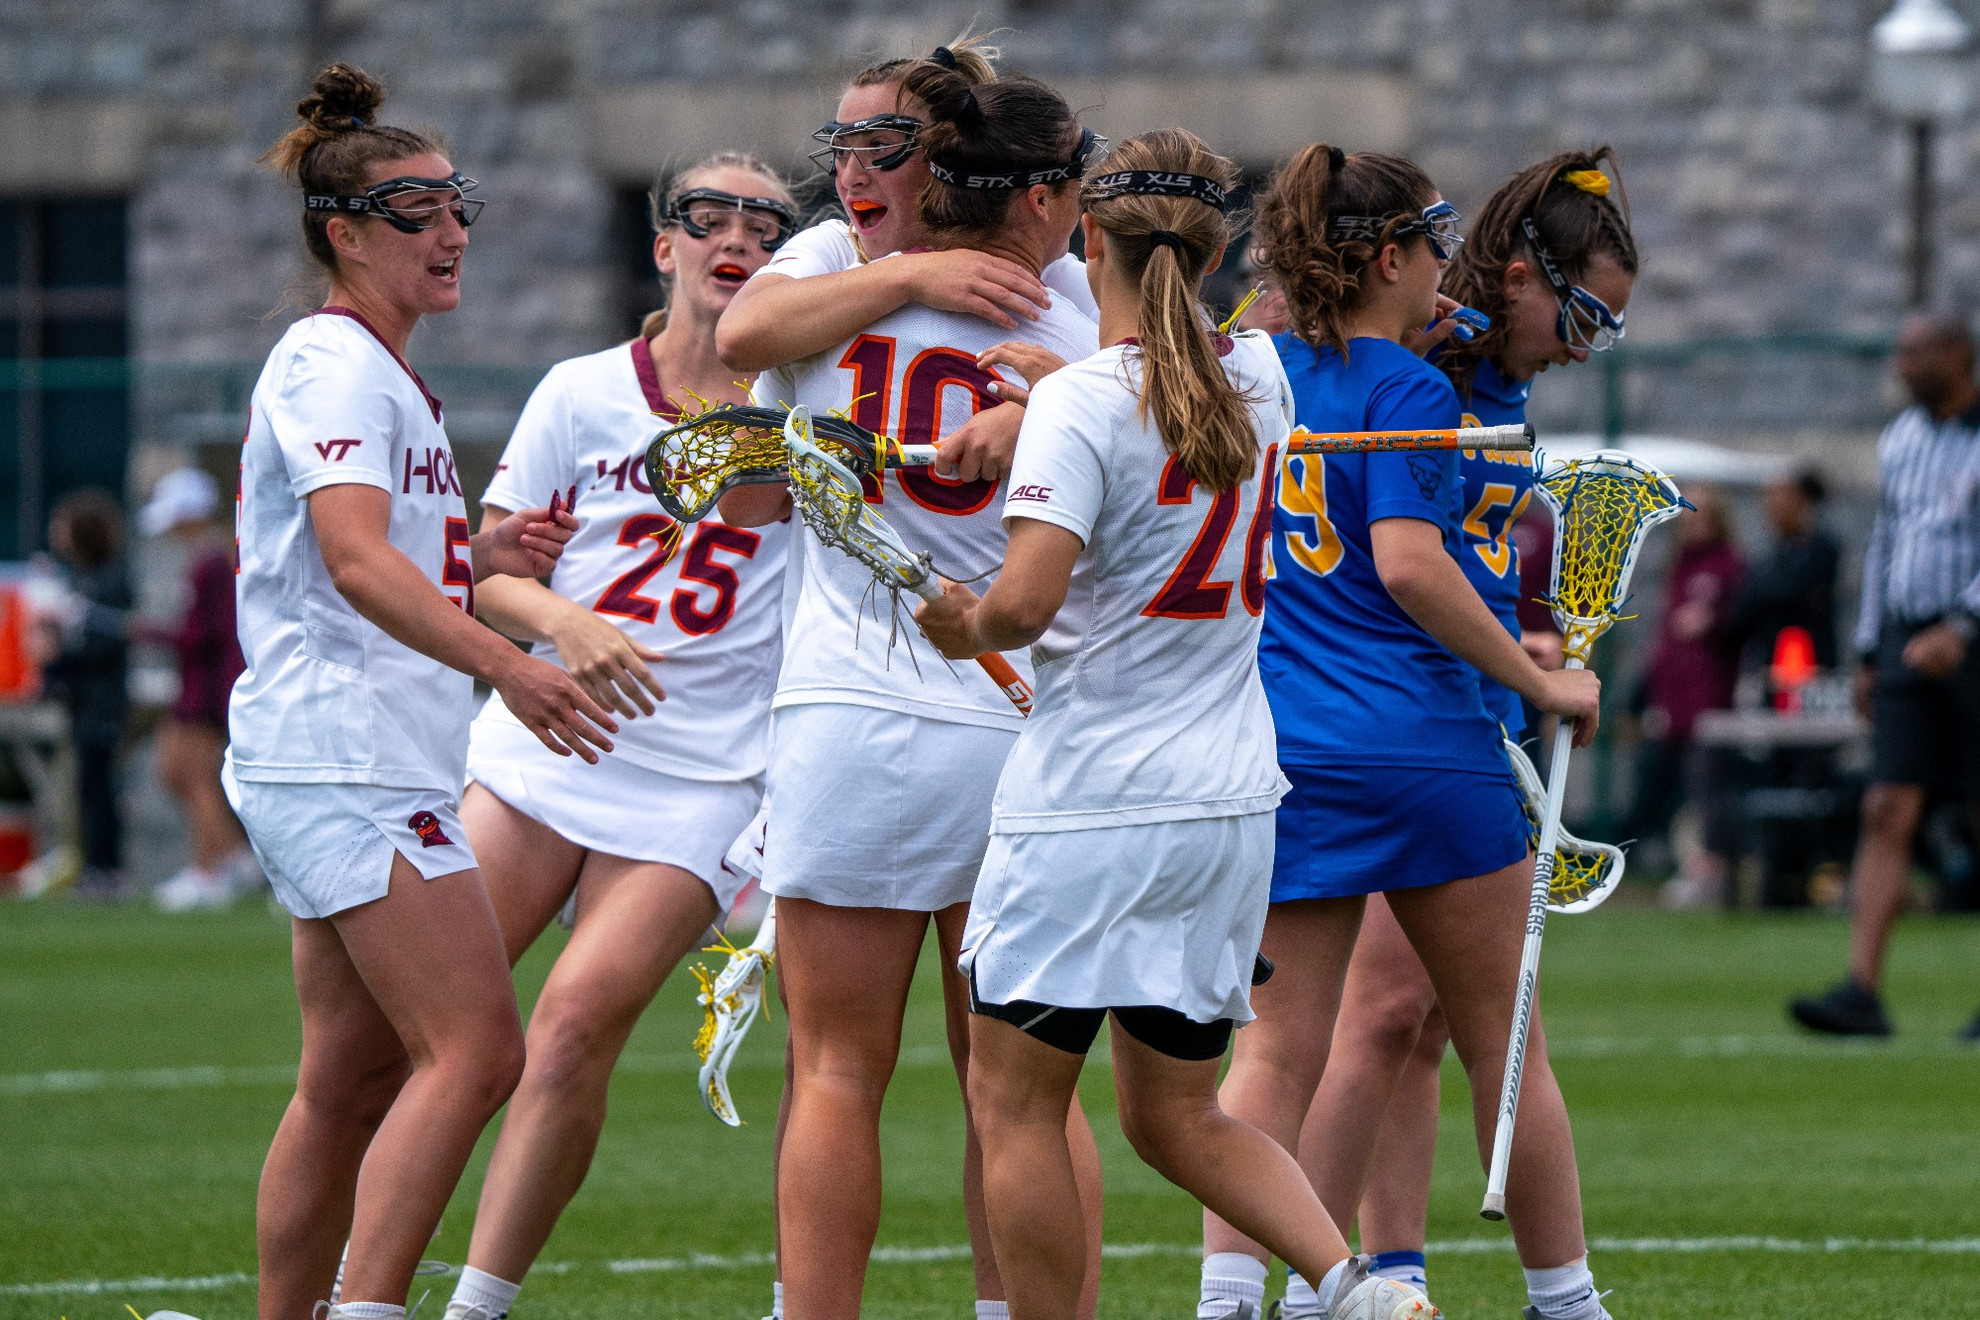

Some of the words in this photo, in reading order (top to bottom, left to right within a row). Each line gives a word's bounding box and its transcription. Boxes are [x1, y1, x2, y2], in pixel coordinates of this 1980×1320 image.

[929, 161, 954, 183] STX
[966, 175, 1014, 188] STX
[1028, 166, 1070, 185] STX
[1145, 172, 1193, 187] STX
[308, 194, 338, 208] STX
[837, 333, 1006, 516] 10
[313, 439, 363, 463] VT
[1008, 485, 1054, 500] ACC
[592, 513, 761, 637] 25
[1526, 852, 1554, 937] PANTHERS
